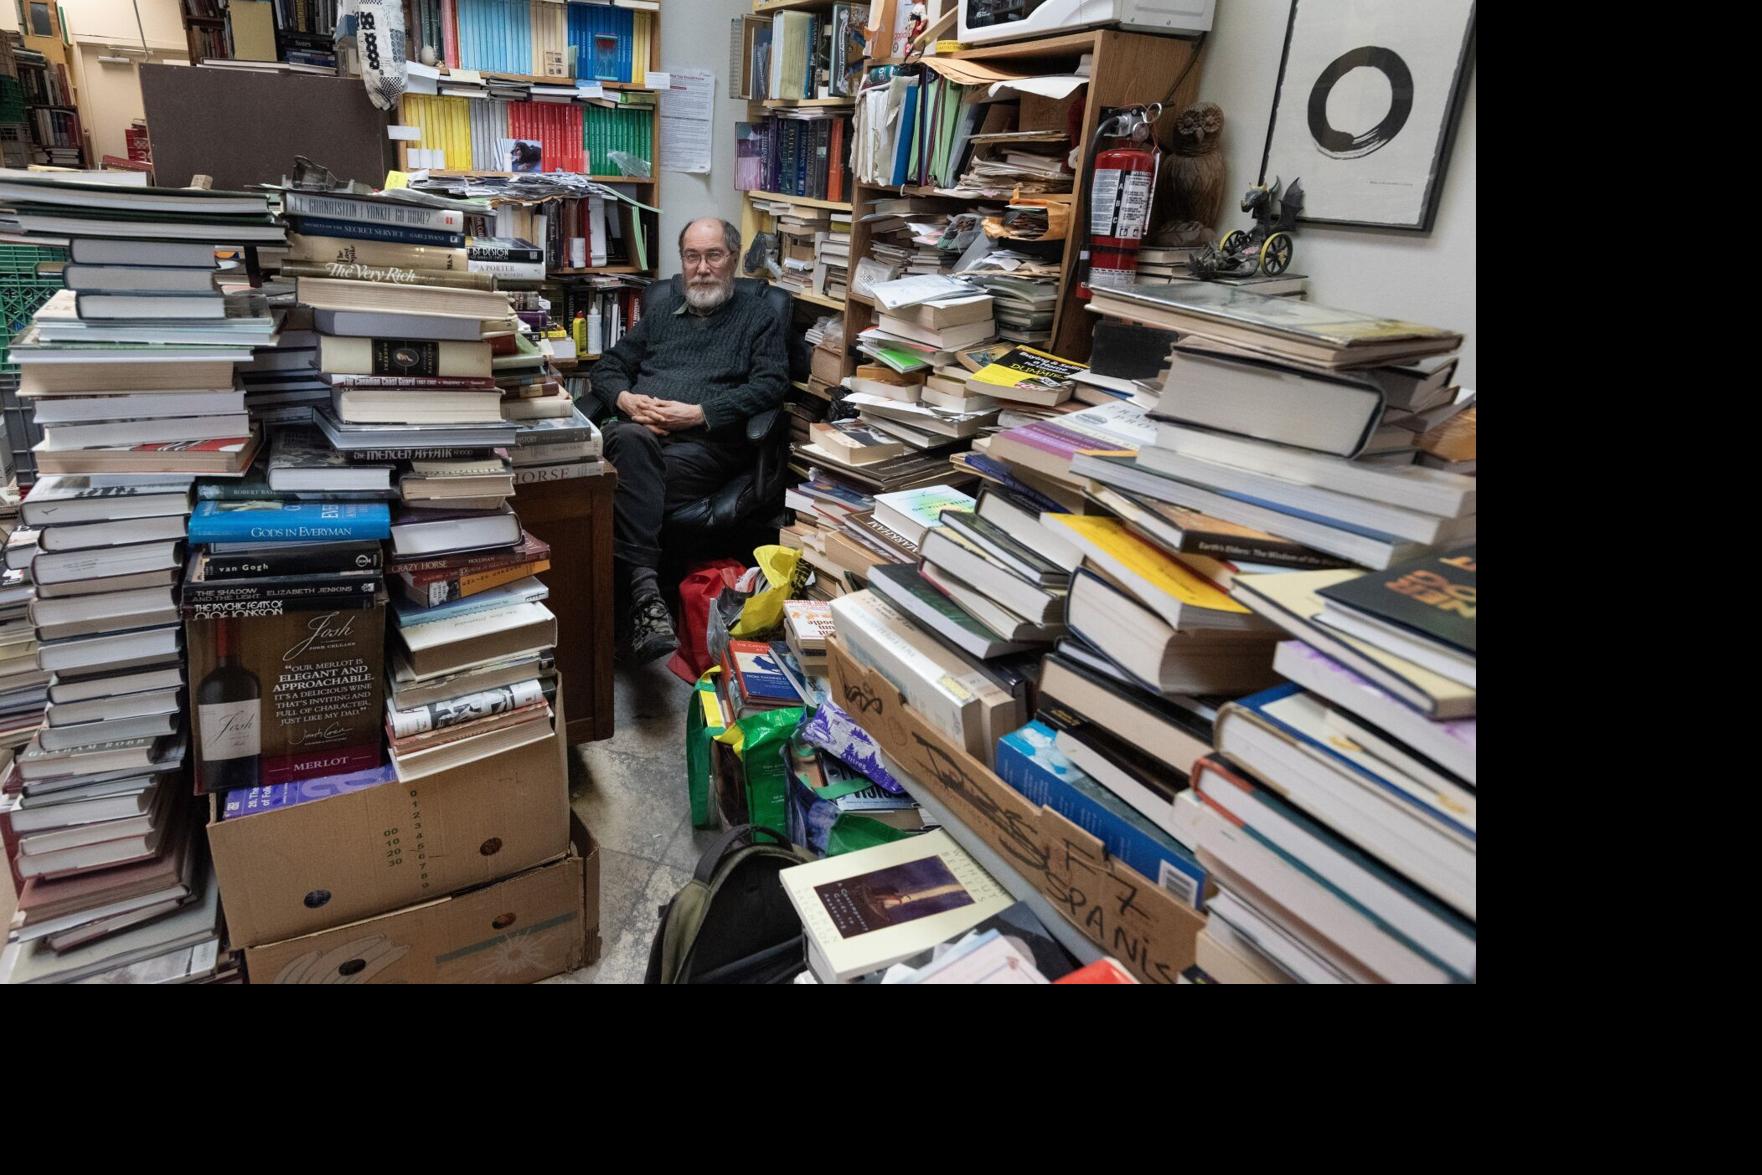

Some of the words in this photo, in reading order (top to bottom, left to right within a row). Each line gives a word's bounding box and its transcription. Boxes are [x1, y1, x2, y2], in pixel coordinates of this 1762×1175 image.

[309, 199, 357, 217] GRANATSTEIN
[366, 204, 391, 221] YANKEE
[344, 225, 373, 235] SECRET
[325, 262, 353, 278] The
[352, 263, 386, 284] Very
[386, 267, 417, 285] Rich
[242, 563, 269, 573] Gogh
[391, 562, 419, 573] CRAZY
[420, 559, 448, 569] HORSE
[217, 587, 258, 596] SHADOW
[266, 588, 315, 597] ELIZABETH
[317, 585, 353, 594] JENKINS
[282, 611, 356, 662] Josh
[315, 659, 354, 670] MERLOT
[279, 668, 338, 683] ELEGANT
[341, 665, 369, 676] AND
[272, 673, 375, 693] APPROACHABLE.
[300, 685, 349, 698] DELICIOUS
[293, 755, 350, 772] MERLOT
